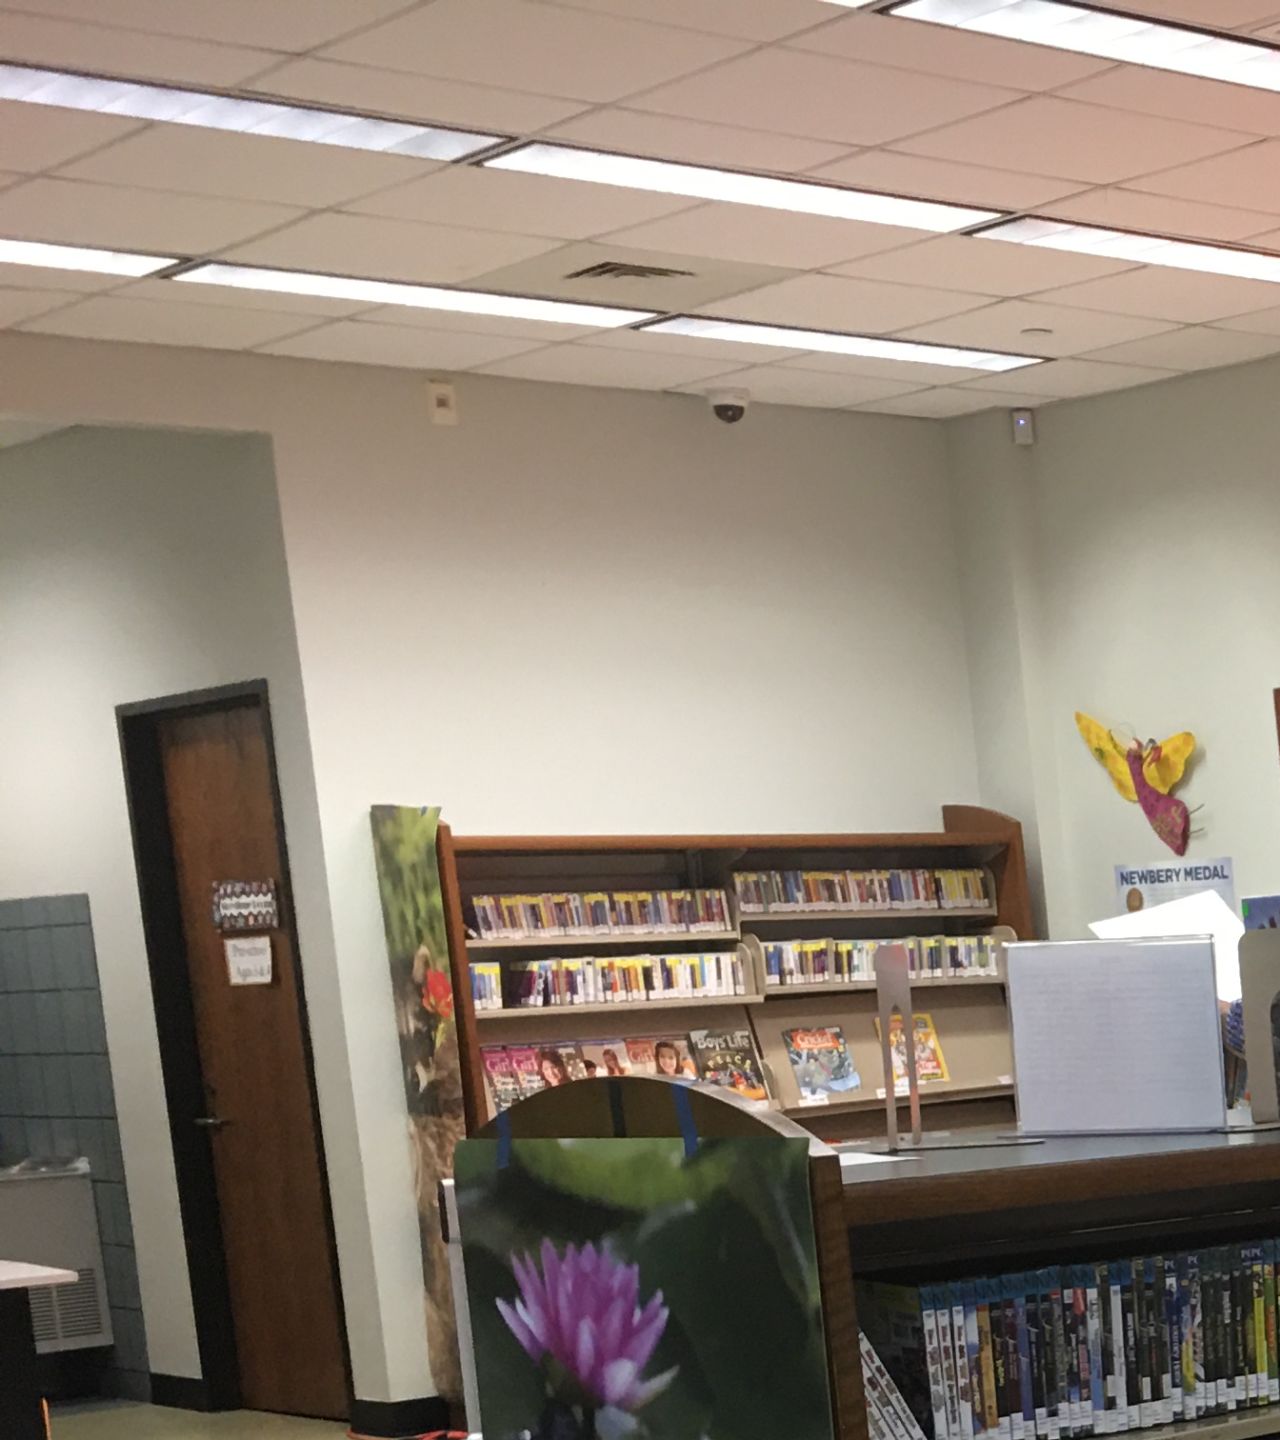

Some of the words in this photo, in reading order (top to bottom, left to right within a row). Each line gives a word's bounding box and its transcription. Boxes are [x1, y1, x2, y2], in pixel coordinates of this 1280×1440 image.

[1120, 868, 1181, 886] NEWBERY
[1184, 865, 1229, 881] MEDAL
[727, 1034, 751, 1049] Life
